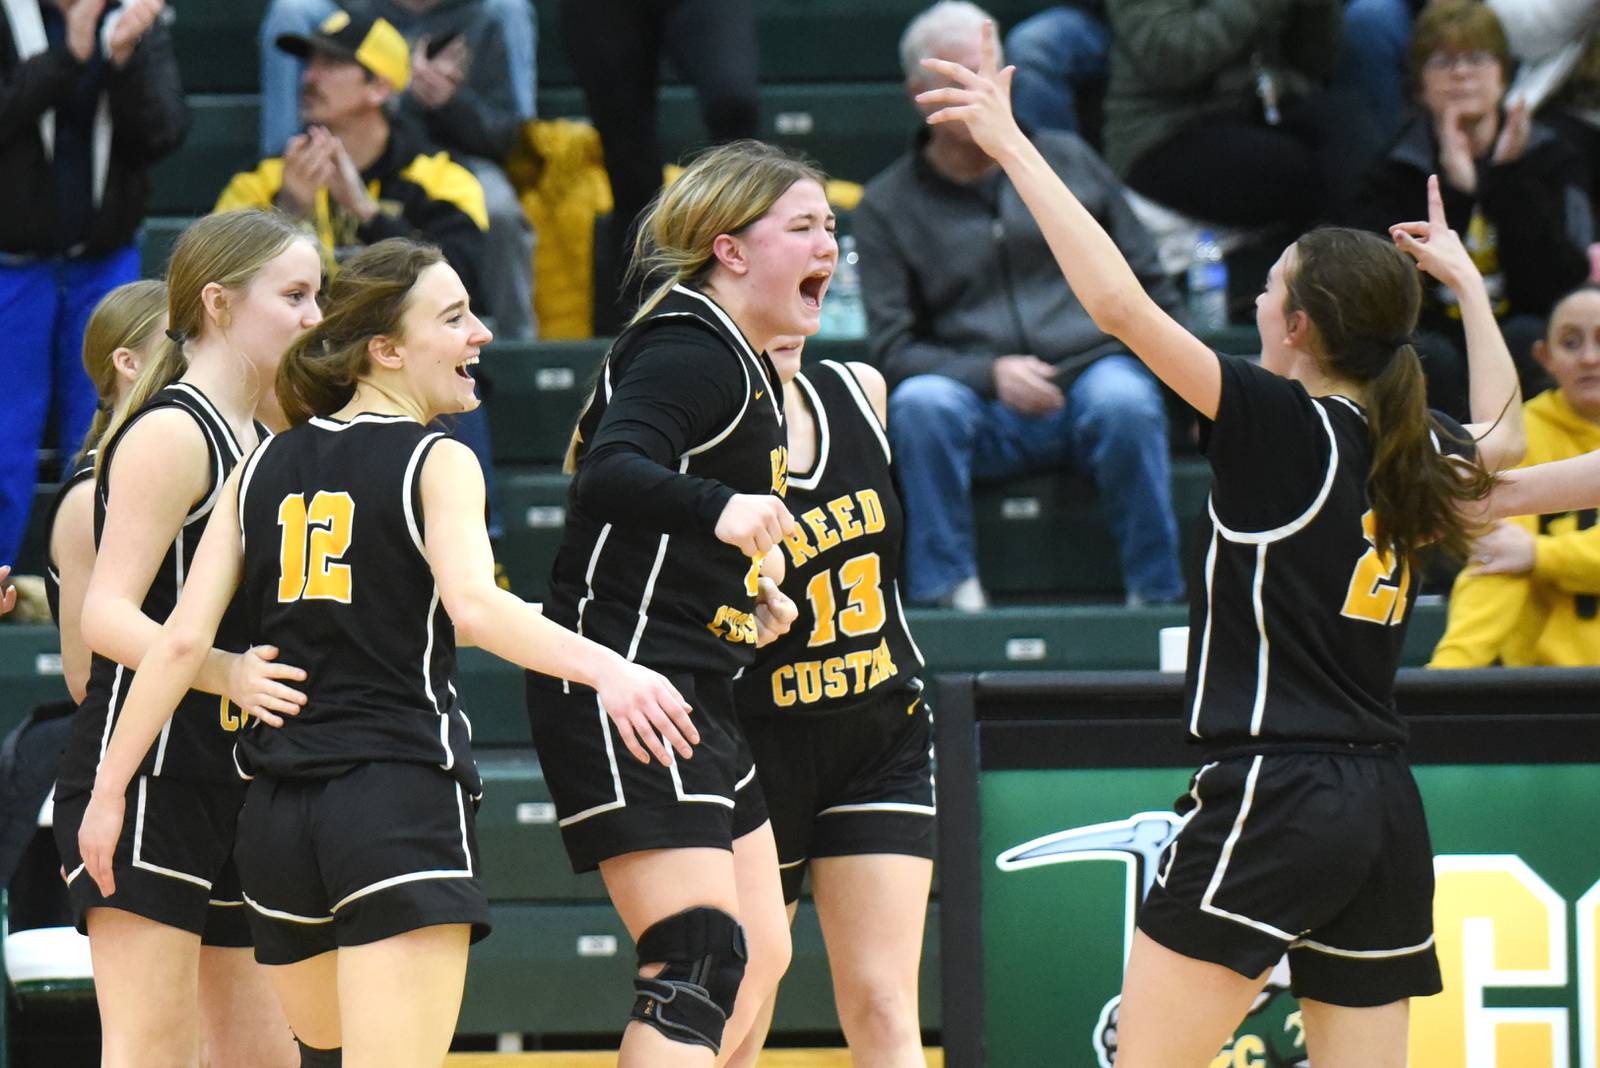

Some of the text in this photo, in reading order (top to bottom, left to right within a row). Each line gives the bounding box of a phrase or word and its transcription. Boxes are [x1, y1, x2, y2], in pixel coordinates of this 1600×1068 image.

[277, 489, 356, 604] 12
[783, 488, 886, 568] REED
[806, 551, 886, 648] 13
